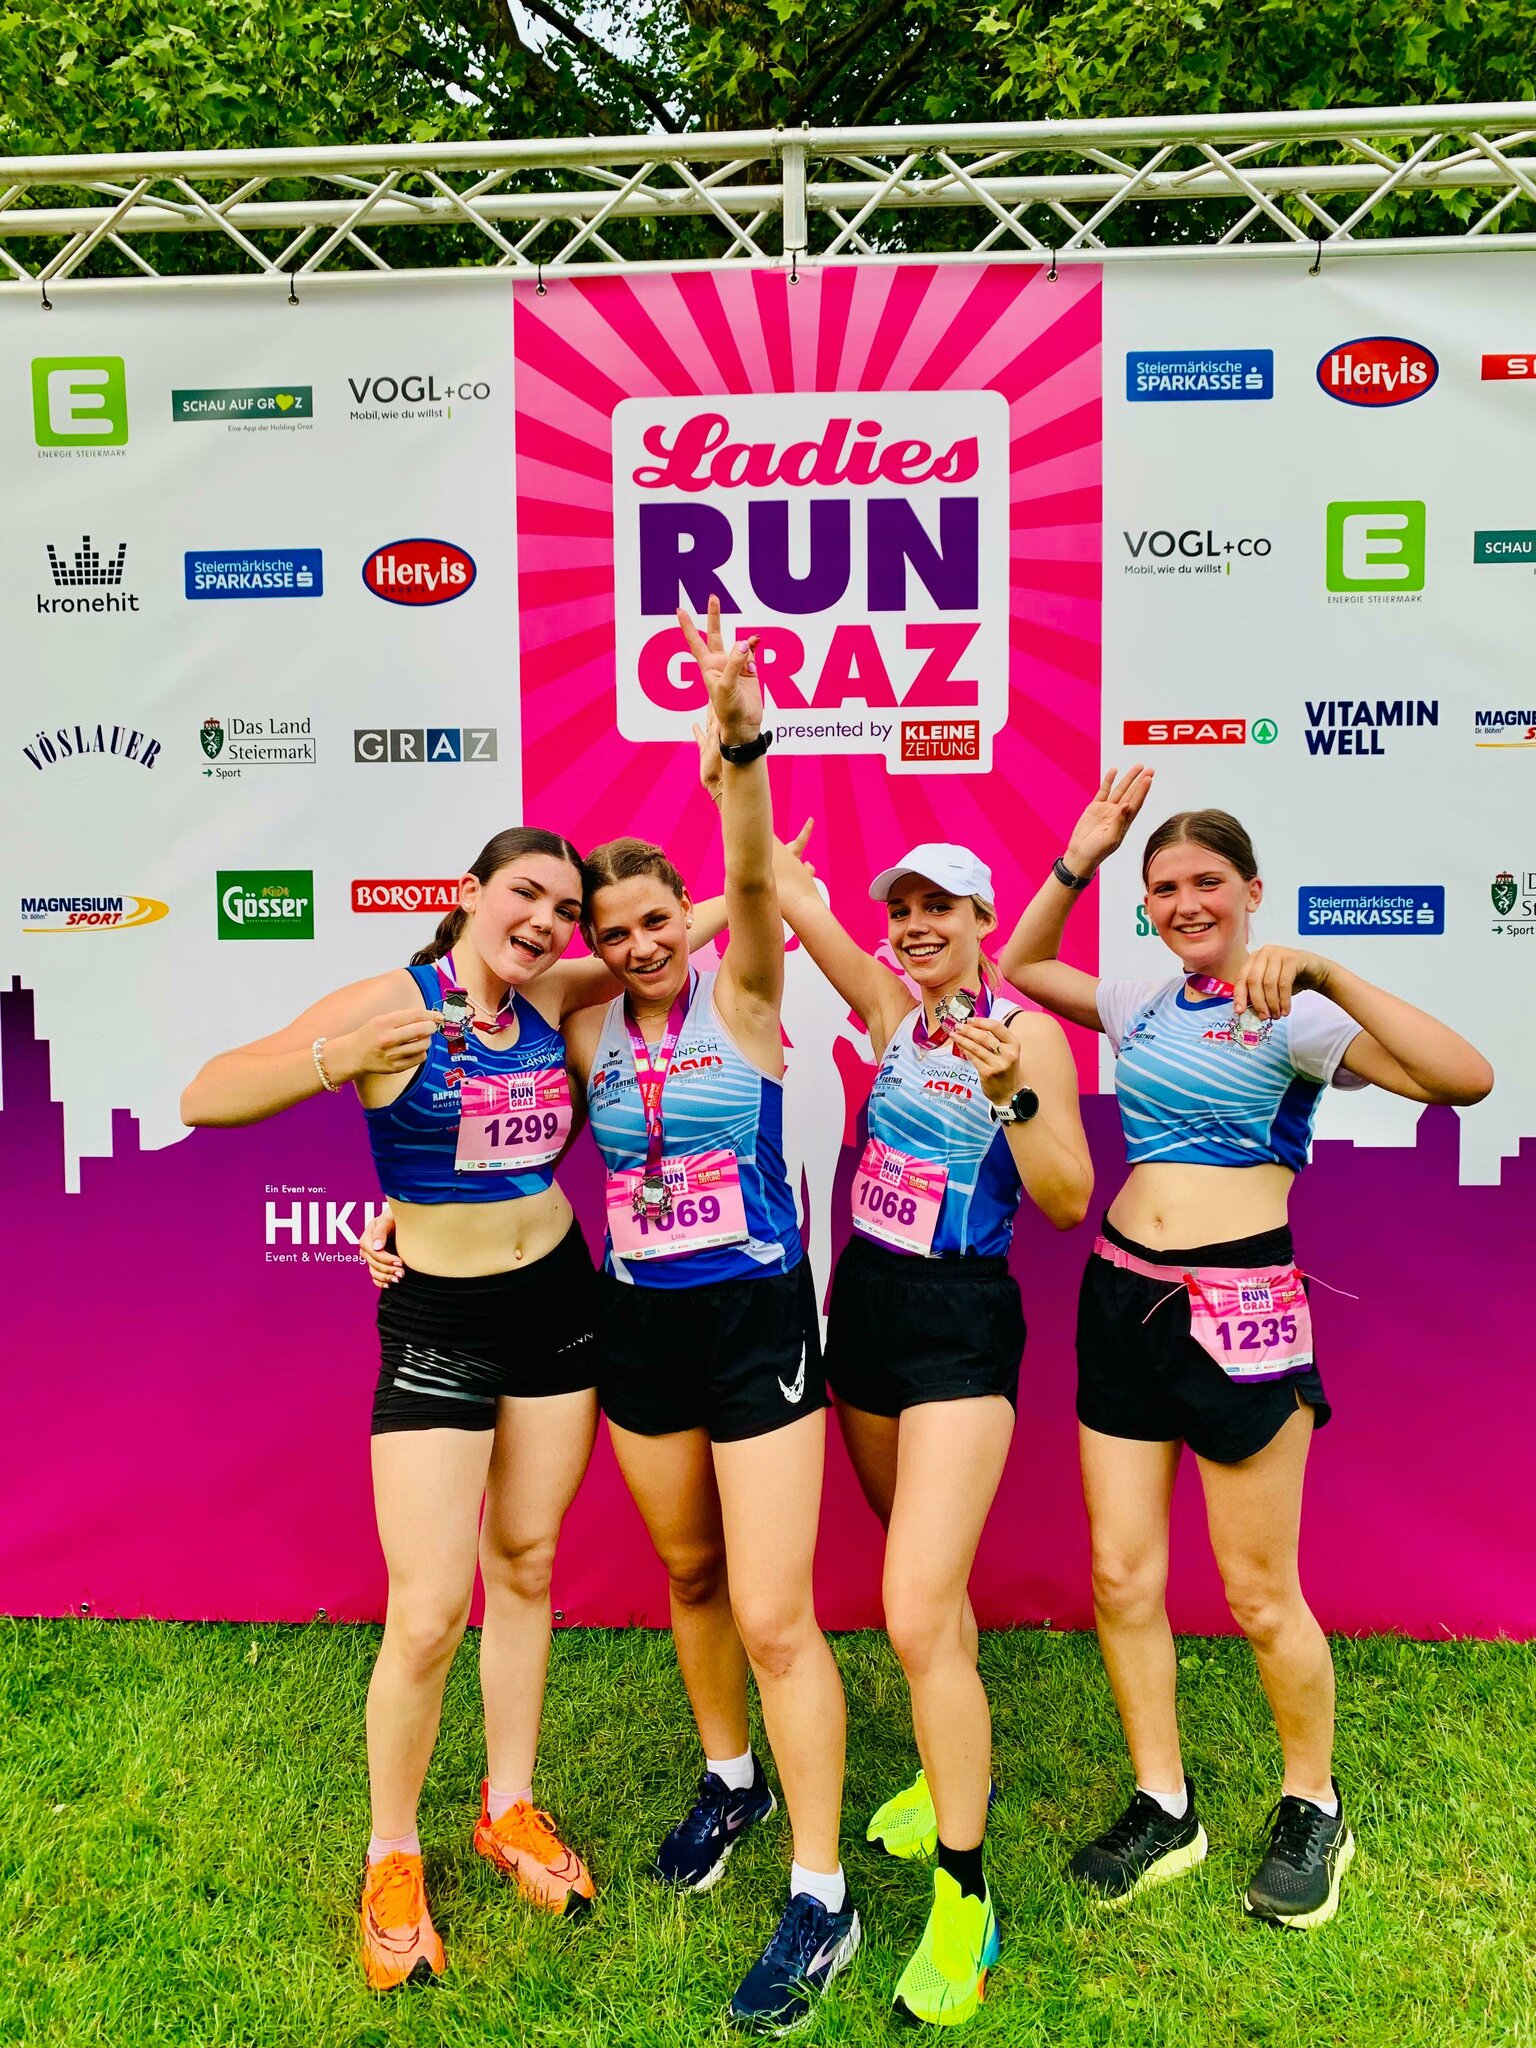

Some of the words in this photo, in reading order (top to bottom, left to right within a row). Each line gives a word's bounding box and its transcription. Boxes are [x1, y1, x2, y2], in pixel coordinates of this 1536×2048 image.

[1136, 360, 1242, 374] Steiermärkische
[1331, 355, 1428, 391] Hervis
[1507, 358, 1536, 375] S
[1136, 374, 1242, 391] SPARKASSE
[182, 400, 226, 412] SCHAU
[229, 398, 254, 411] AUF
[402, 409, 415, 419] du
[418, 408, 443, 418] willst
[243, 424, 257, 433] App
[258, 423, 269, 431] der
[270, 423, 296, 432] Holding
[37, 450, 72, 459] ENERGIE
[76, 449, 127, 458] STEIERMARK
[632, 413, 980, 493] Ladies
[1485, 541, 1532, 554] SCHAU
[639, 497, 979, 616] RUN
[195, 559, 294, 573] Steiermärkische
[375, 555, 467, 591] Hervis
[1178, 564, 1192, 574] du
[1195, 563, 1222, 574] willst
[195, 572, 294, 590] SPARKASSE
[37, 592, 140, 614] kronehit
[1327, 596, 1364, 604] ENERGIE
[1368, 595, 1422, 604] STEIERMARK
[637, 622, 982, 712] GRAZ
[1305, 700, 1439, 727] VITAMIN
[232, 718, 263, 735] Das
[269, 717, 311, 734] Land
[776, 721, 864, 743] presented
[870, 721, 893, 743] by
[905, 725, 976, 741] KLEINE
[1147, 724, 1243, 741] SPAR
[1524, 727, 1536, 740] S
[22, 724, 162, 771] VÖSLAUER
[356, 731, 493, 762] GRAZ
[905, 740, 976, 757] ZEITUNG
[1305, 730, 1385, 755] WELL
[229, 744, 312, 760] Steiermark
[216, 767, 241, 780] Sport
[21, 897, 123, 912] MAGNESIUM
[222, 886, 308, 924] Gösser
[1308, 896, 1414, 909] Steiermärkische
[66, 913, 122, 925] SPORT
[1308, 909, 1414, 925] SPARKASSE
[1506, 925, 1535, 937] Sport
[510, 1086, 534, 1099] RUN
[511, 1097, 534, 1108] GRAZ
[484, 1112, 558, 1147] 1299
[883, 1160, 902, 1176] RUN
[664, 1172, 684, 1185] UN
[881, 1171, 900, 1184] GRAZ
[265, 1184, 279, 1194] Ein
[281, 1184, 305, 1194] Event
[307, 1185, 327, 1194] von:
[665, 1184, 686, 1194] RAZ
[860, 1180, 917, 1226] 1068
[632, 1195, 720, 1235] 1069
[265, 1251, 297, 1262] Event
[301, 1251, 310, 1262] &
[314, 1251, 367, 1265] Werbeag
[1241, 1289, 1270, 1302] RUN
[1243, 1301, 1271, 1311] GRAZ
[1216, 1314, 1297, 1351] 1235
